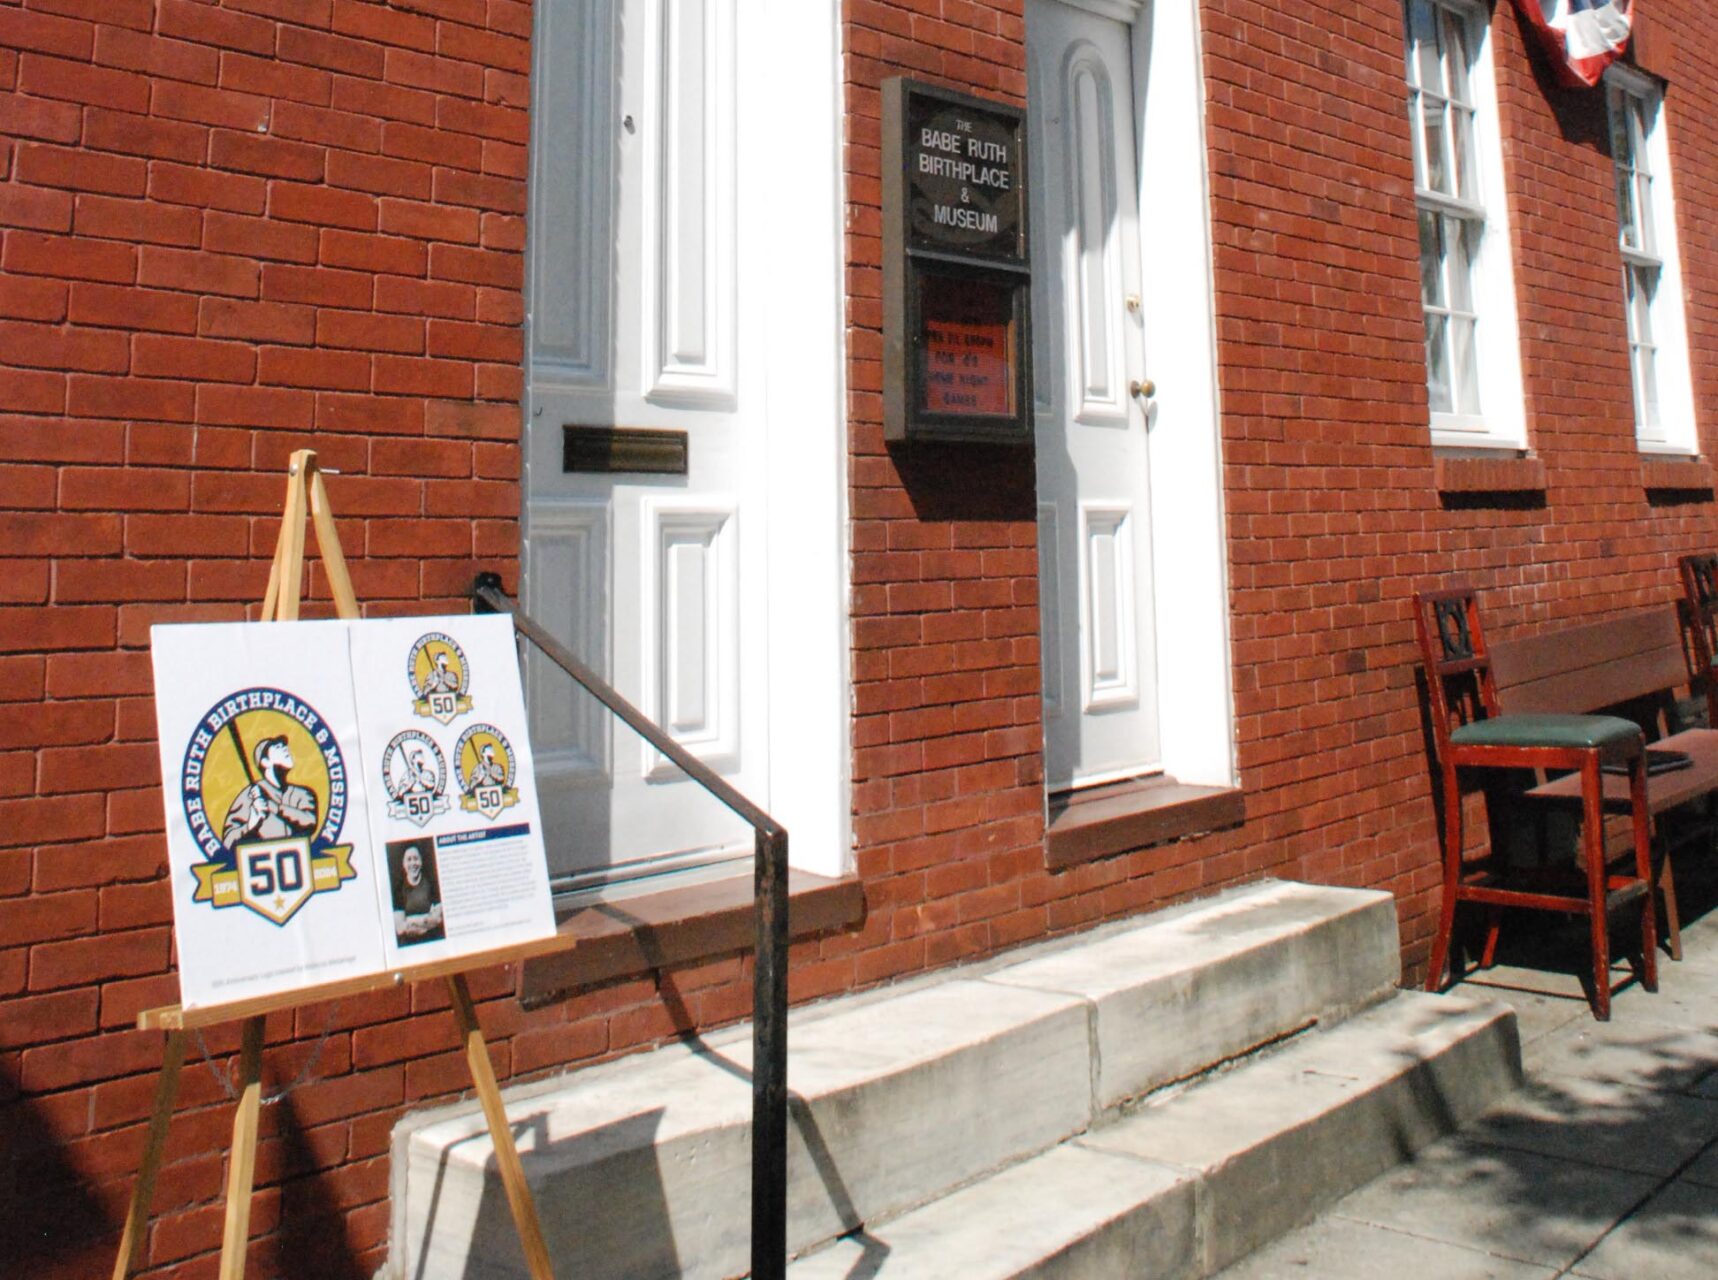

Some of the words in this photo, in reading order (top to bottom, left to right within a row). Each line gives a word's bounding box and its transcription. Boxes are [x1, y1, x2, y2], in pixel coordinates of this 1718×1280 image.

[956, 119, 973, 132] THE
[922, 128, 961, 153] BABE
[968, 138, 1007, 163] RUTH
[919, 153, 1009, 189] BIRTHPLACE
[961, 187, 970, 203] &
[934, 204, 998, 233] MUSEUM
[206, 692, 318, 732] BIRTHPLACE
[433, 697, 453, 714] 50
[315, 728, 329, 744] &
[185, 728, 212, 792] RUTH
[322, 746, 345, 843] MUSEUM
[409, 796, 430, 815] 50
[480, 790, 500, 808] 50
[186, 797, 221, 857] BABE
[248, 849, 304, 897] 50
